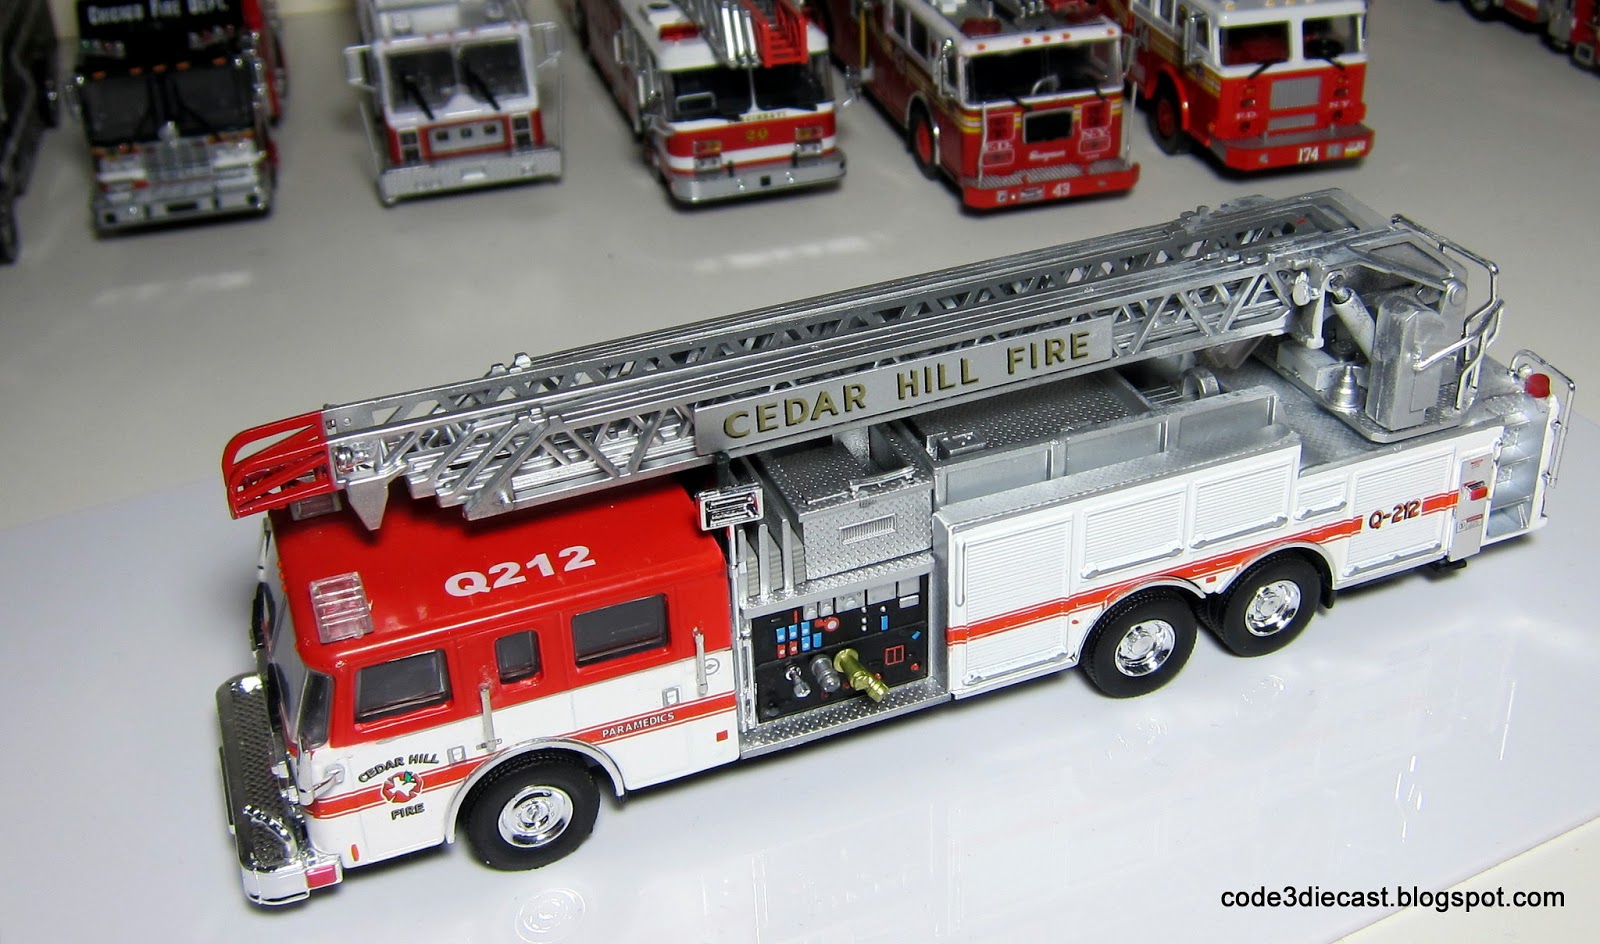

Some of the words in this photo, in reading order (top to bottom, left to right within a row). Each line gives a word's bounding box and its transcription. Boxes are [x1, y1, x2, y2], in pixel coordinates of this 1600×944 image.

[1298, 146, 1320, 164] 174
[1052, 182, 1070, 198] 43
[723, 383, 867, 439] CEDAR
[897, 357, 979, 401] HILL
[1007, 331, 1090, 375] FIRE
[1368, 498, 1421, 529] Q-212
[444, 545, 597, 597] Q212
[601, 711, 675, 738] PARAMEDICS
[358, 756, 405, 783] CEDAR
[408, 753, 440, 765] HILL
[391, 802, 426, 821] FIRE
